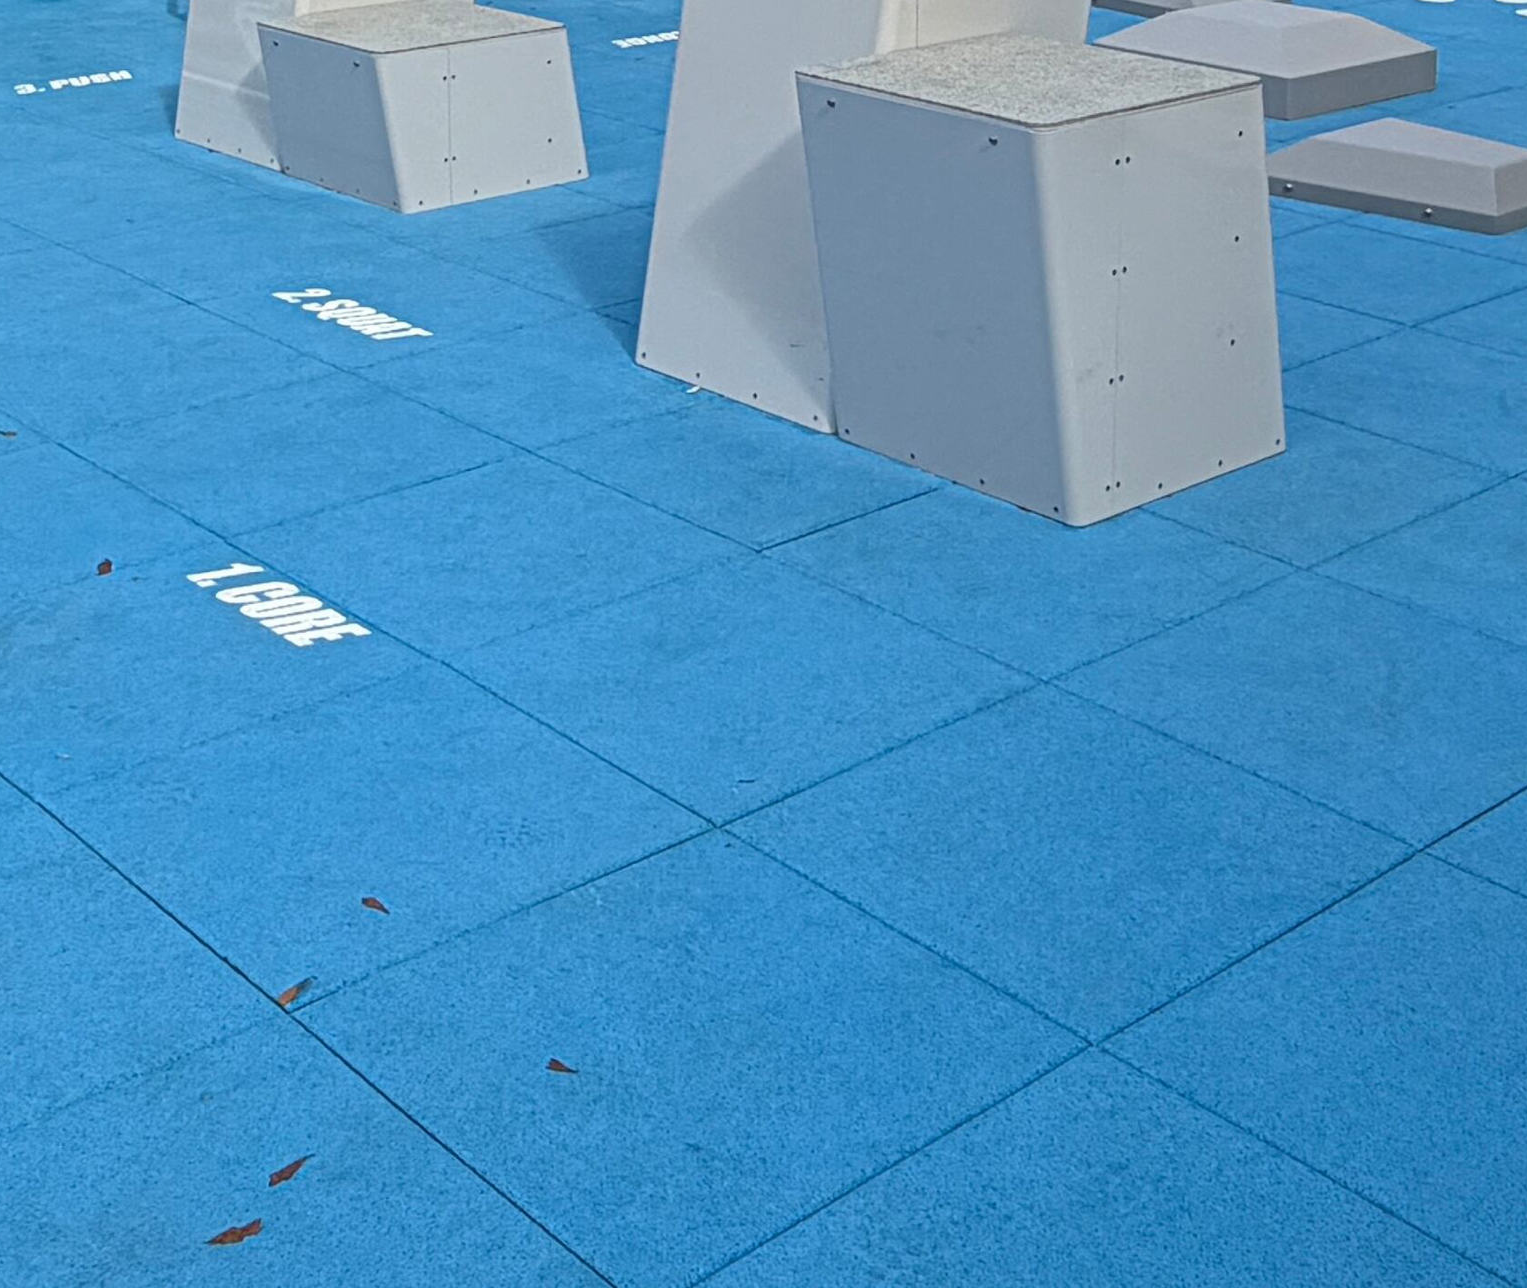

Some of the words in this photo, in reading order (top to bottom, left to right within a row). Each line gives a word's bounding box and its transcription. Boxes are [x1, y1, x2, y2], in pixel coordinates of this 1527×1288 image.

[49, 69, 134, 90] PUSH
[301, 299, 434, 340] SQUAT
[186, 563, 265, 588] 1.
[215, 581, 372, 647] CORE
